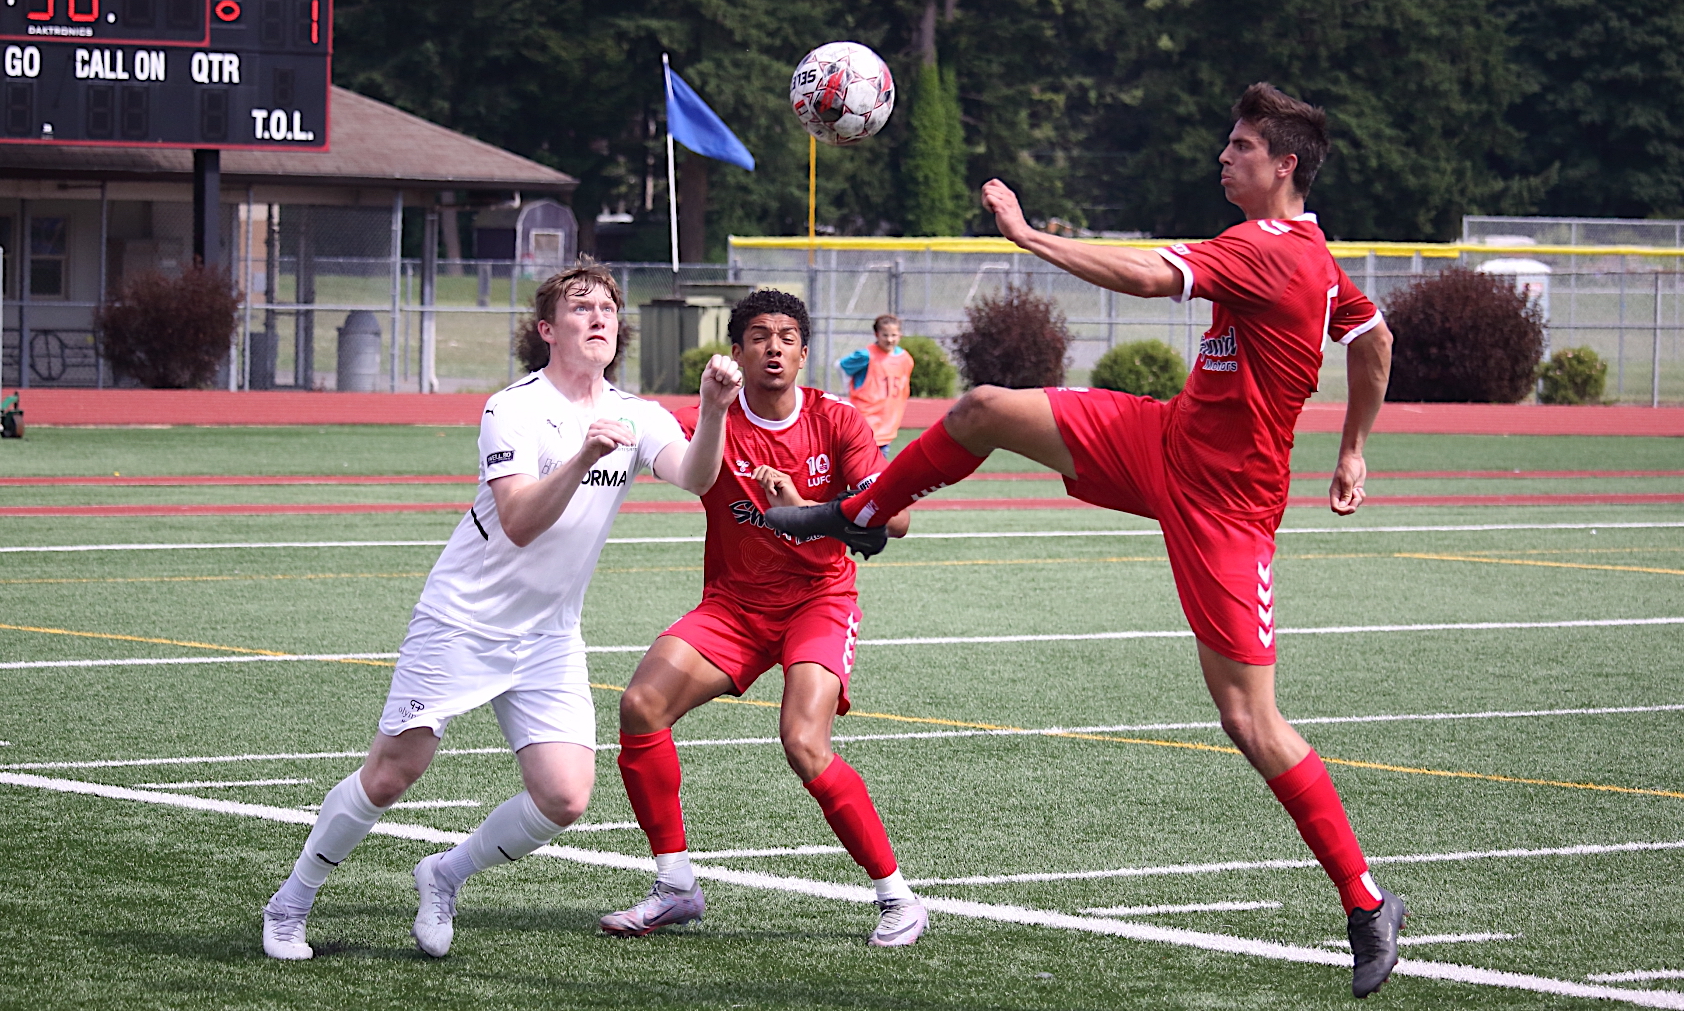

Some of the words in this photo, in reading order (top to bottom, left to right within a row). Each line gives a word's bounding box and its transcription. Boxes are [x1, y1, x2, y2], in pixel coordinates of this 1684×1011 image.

[27, 25, 93, 37] DAKTRONICS
[5, 46, 40, 77] GO
[75, 48, 129, 80] CALL
[134, 50, 165, 81] ON
[191, 52, 240, 83] QTR
[252, 109, 314, 141] T.O.L.
[1202, 359, 1237, 372] Motors
[884, 376, 901, 399] 15
[806, 453, 830, 476] 10
[808, 474, 831, 488] LUFC
